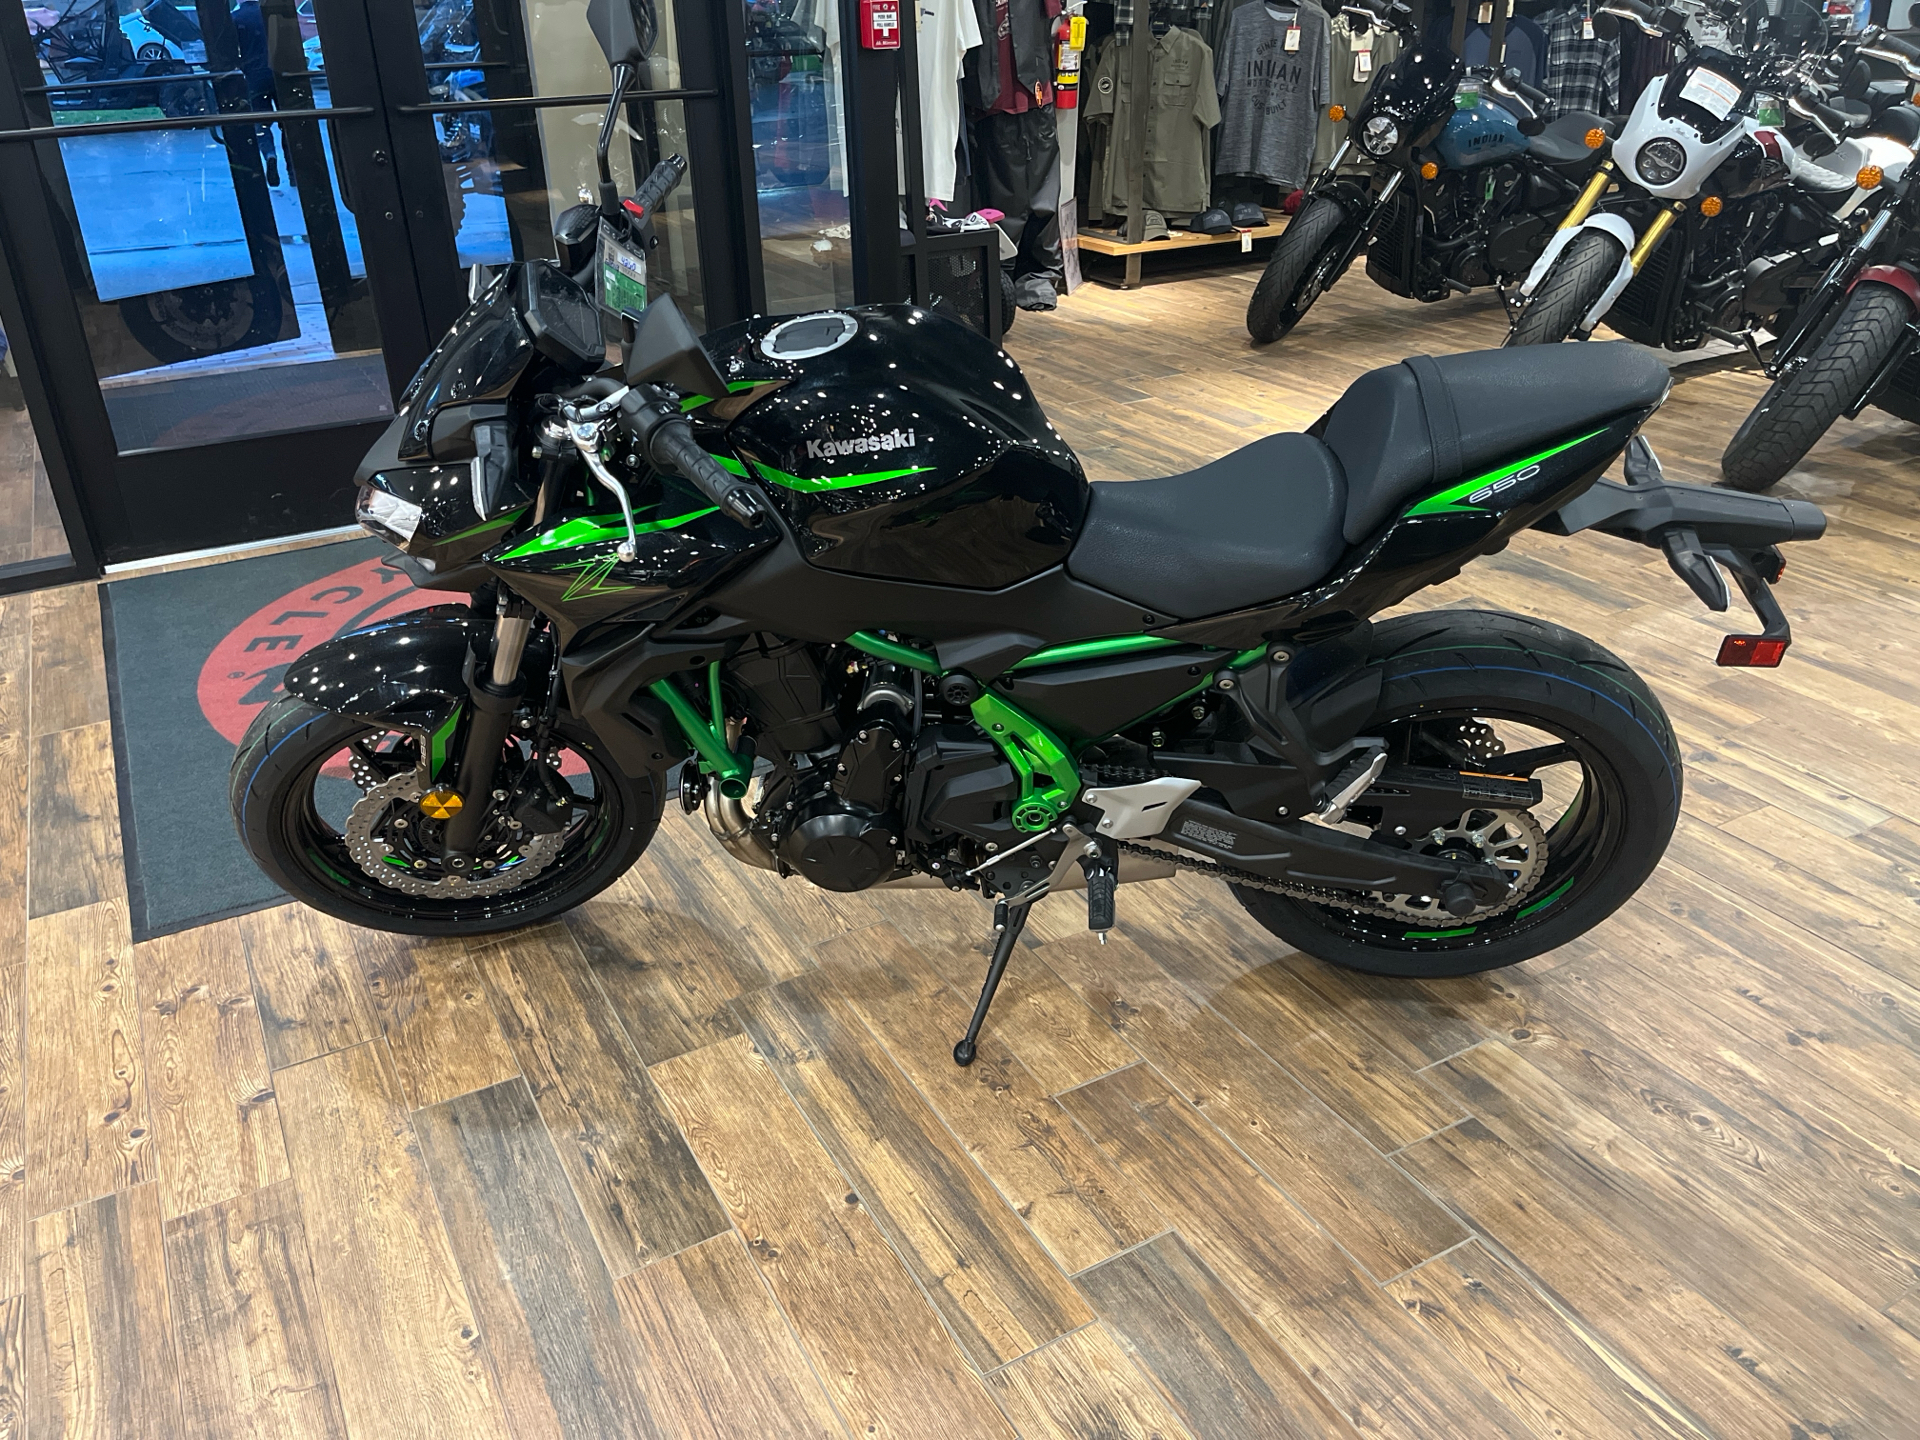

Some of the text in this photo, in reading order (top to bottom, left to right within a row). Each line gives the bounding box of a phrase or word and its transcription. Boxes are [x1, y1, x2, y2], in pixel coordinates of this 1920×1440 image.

[1468, 133, 1505, 148] INDIAN
[806, 428, 916, 459] Kawasaki
[1469, 465, 1541, 504] 650
